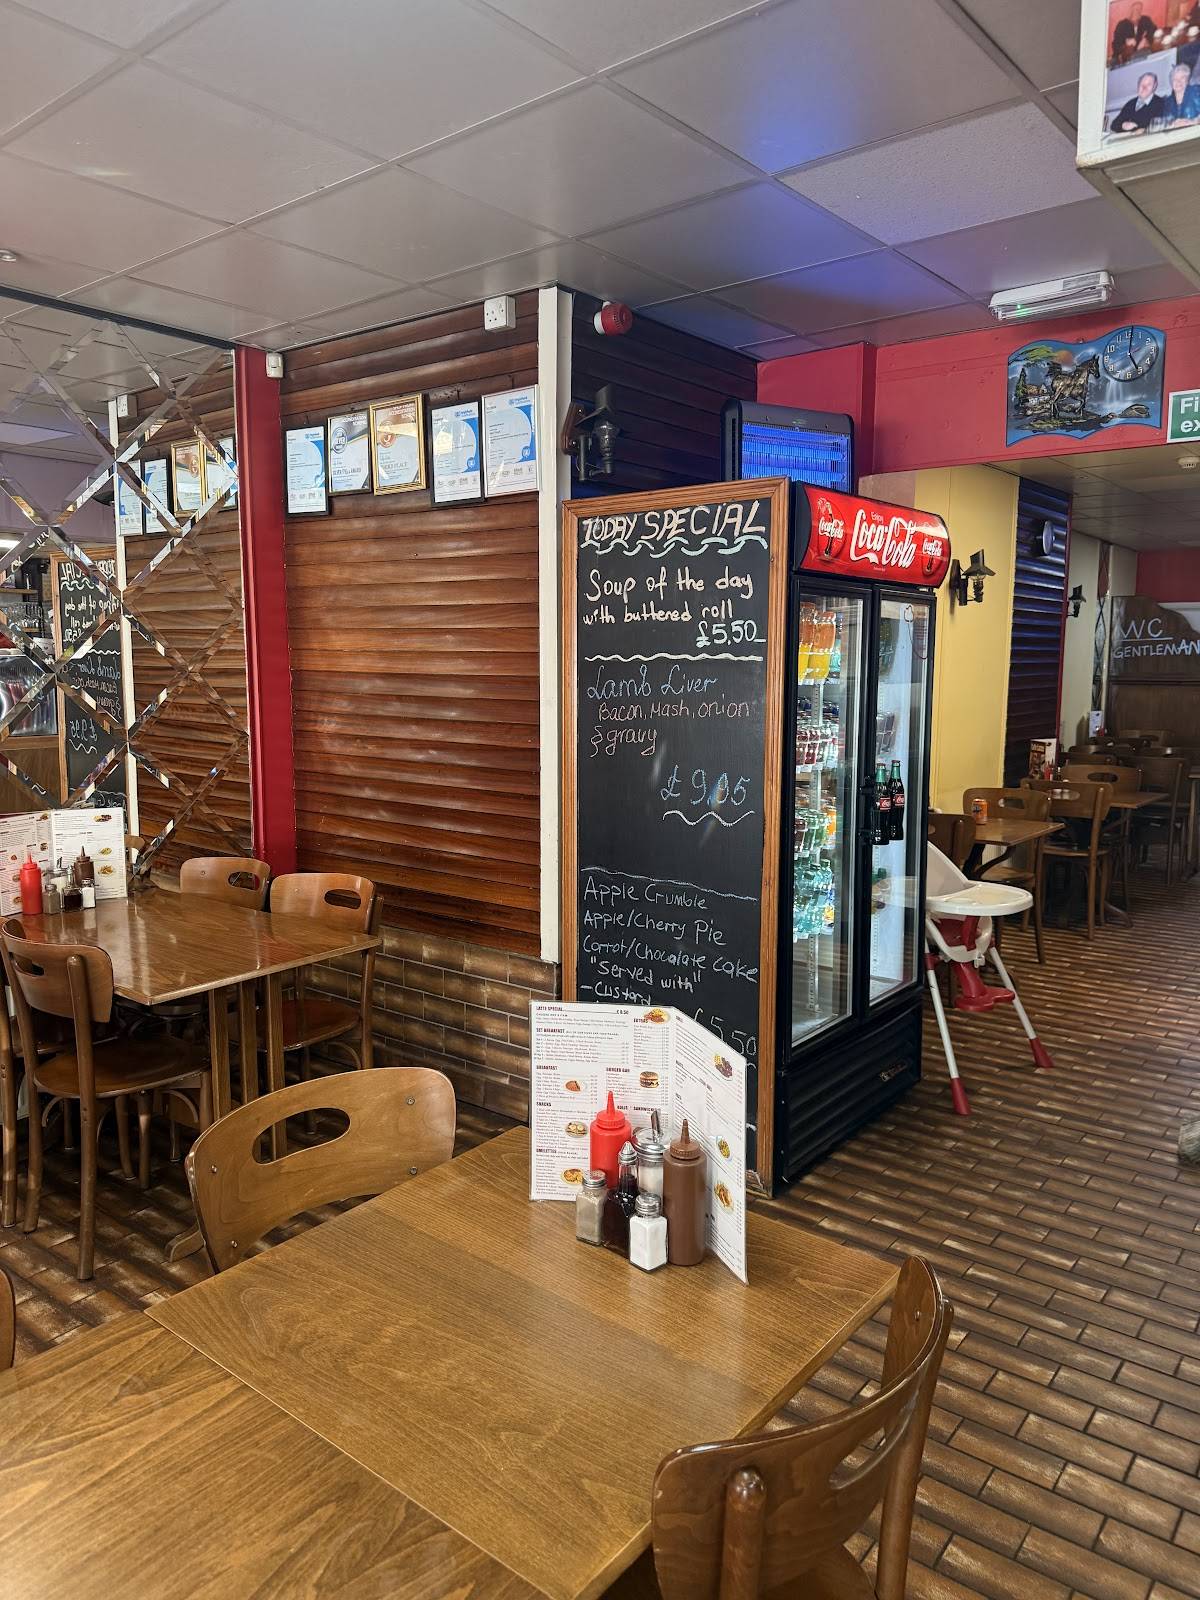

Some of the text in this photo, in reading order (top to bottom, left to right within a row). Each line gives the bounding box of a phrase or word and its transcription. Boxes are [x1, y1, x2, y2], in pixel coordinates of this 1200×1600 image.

[1107, 344, 1115, 353] 10
[1137, 366, 1143, 375] 5
[582, 500, 766, 542] TODAY SPECIAL
[585, 566, 754, 603] Soup of the day
[582, 598, 733, 625] with buttered roll
[1119, 618, 1163, 639] WC
[1112, 639, 1200, 659] GENTLEMAN
[586, 664, 719, 699] Lamb Liver
[599, 702, 646, 722] Bacon,
[605, 728, 657, 755] gravy
[584, 875, 708, 909] Apple Crumble
[583, 909, 727, 946] Apple/Cherry Pie
